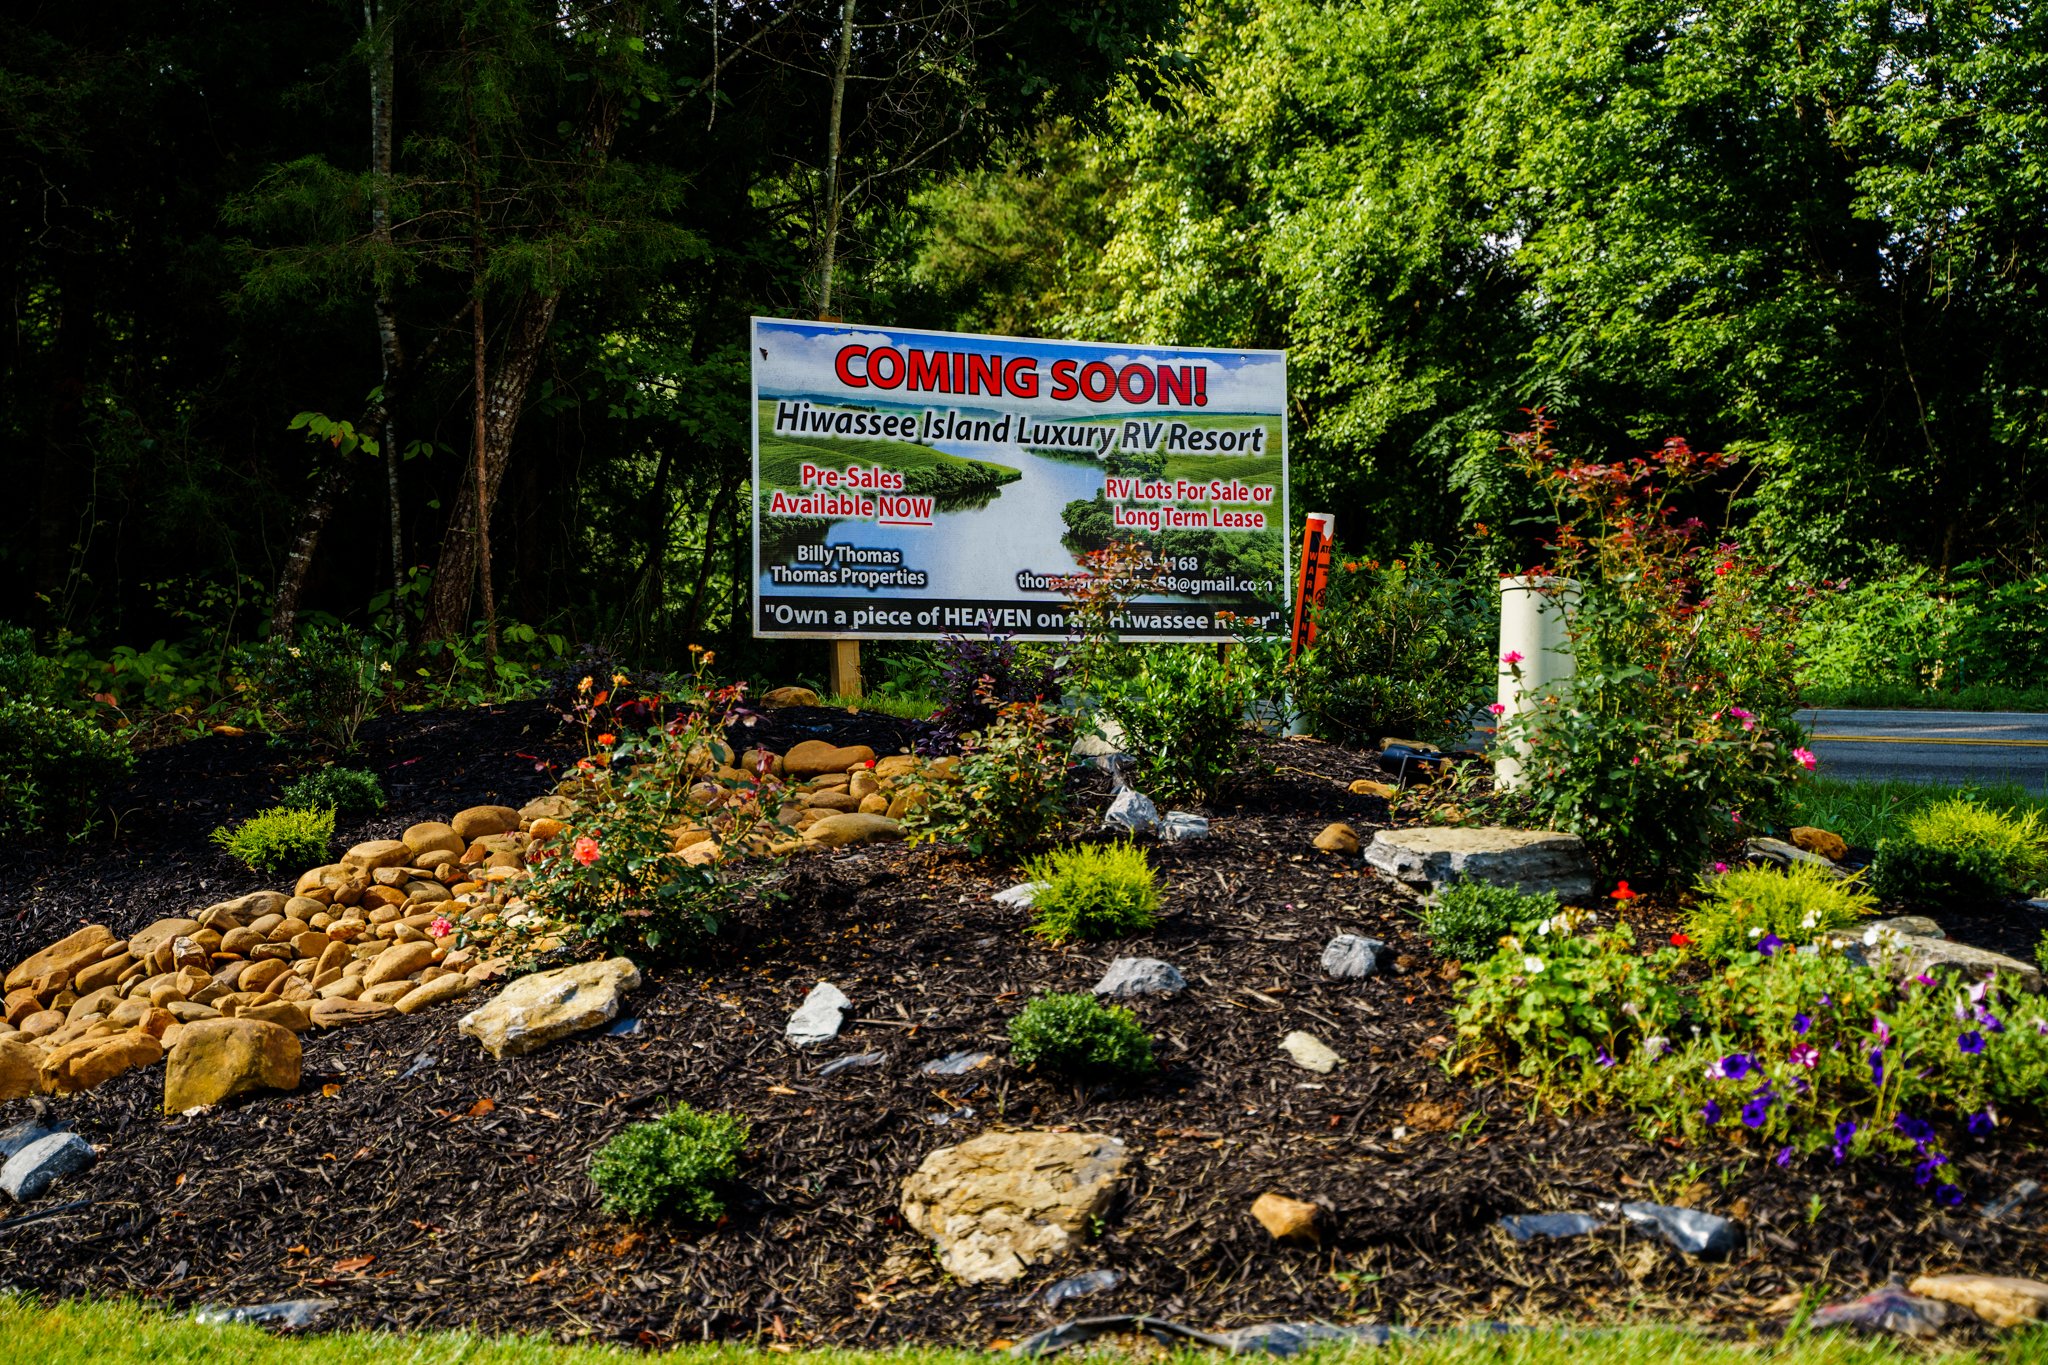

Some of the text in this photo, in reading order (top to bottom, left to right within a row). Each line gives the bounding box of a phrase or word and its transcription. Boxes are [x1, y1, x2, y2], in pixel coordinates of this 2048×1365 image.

[835, 344, 1208, 407] COMING SOON!
[776, 402, 1263, 455] Hiwassee Island Luxury RV Resort
[803, 465, 903, 489] Pre-Sales
[1106, 479, 1272, 501] RV Lots For Sale or
[771, 492, 932, 519] Available NOW
[1115, 506, 1264, 531] Long Term Lease
[797, 545, 900, 566] Billy Thomas
[771, 566, 925, 588] Thomas Properties
[1300, 551, 1318, 646] WARNING
[765, 604, 1280, 630] "Own a piece of HEAVEN on th Hiwassee Rer"
